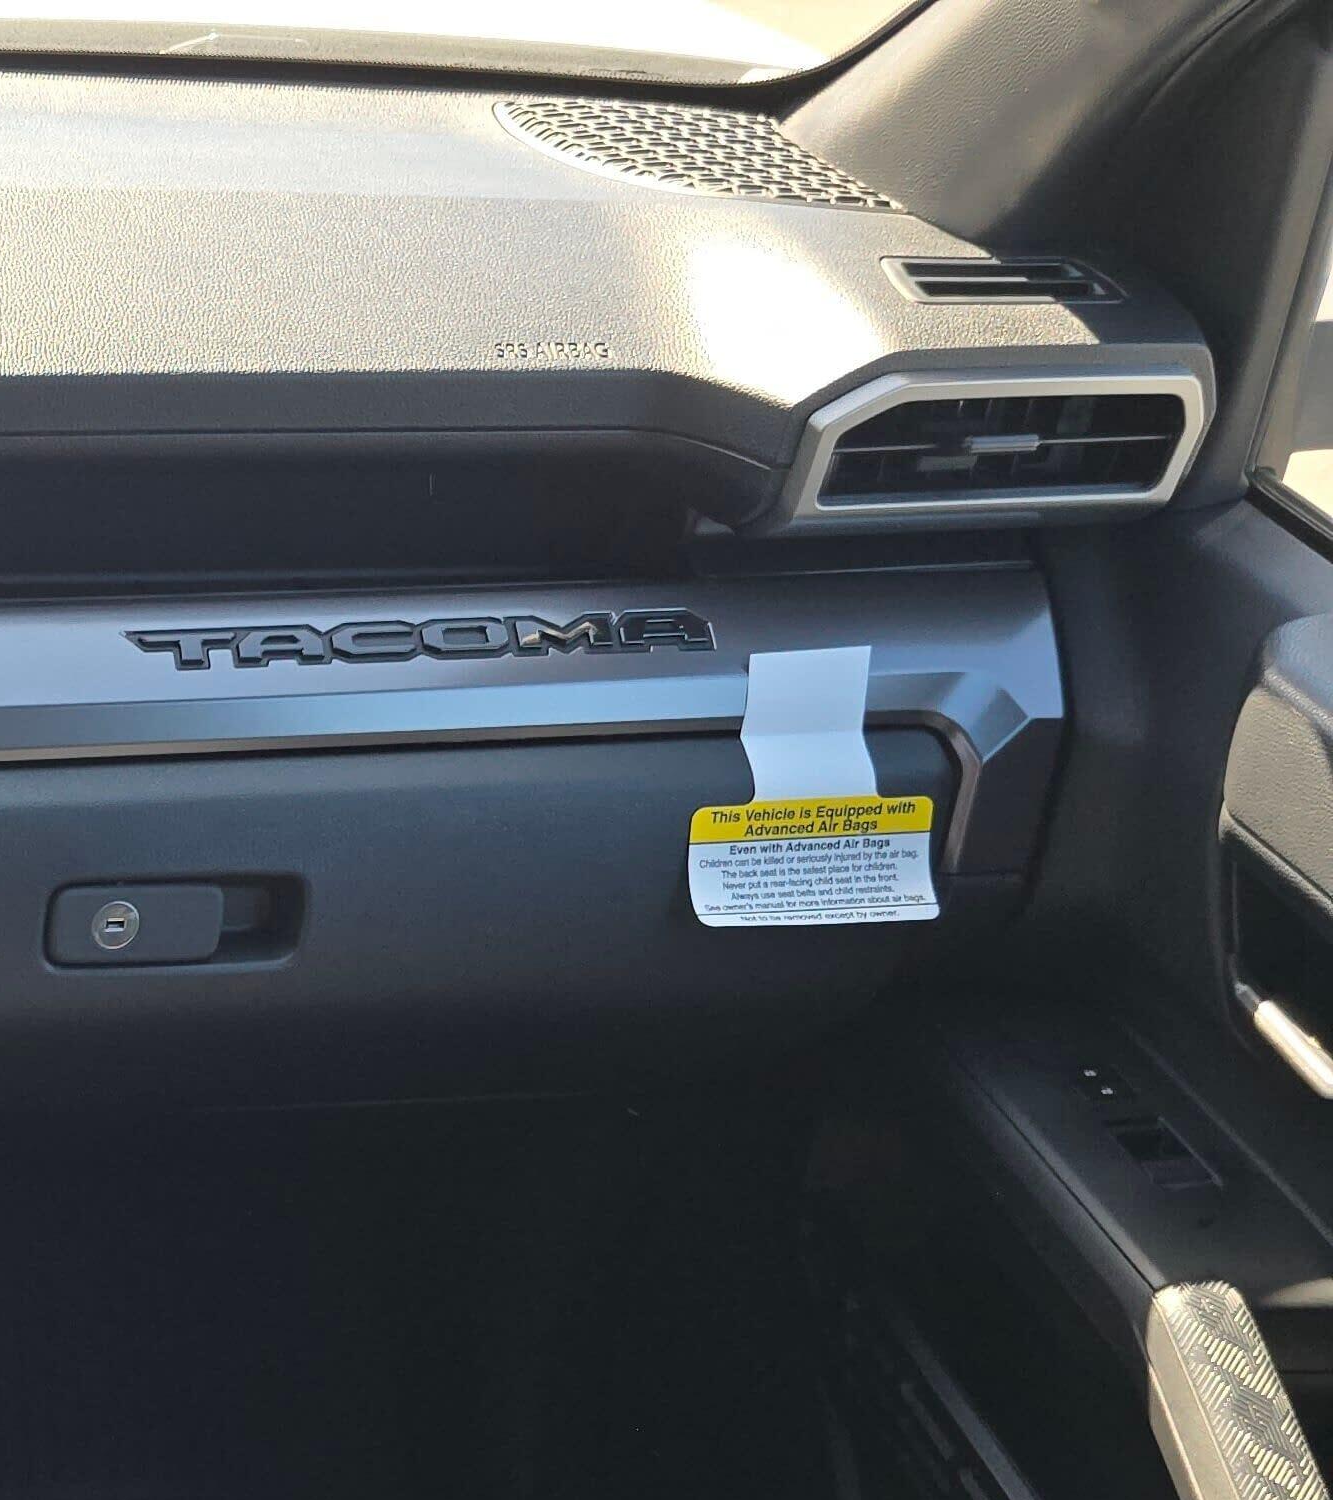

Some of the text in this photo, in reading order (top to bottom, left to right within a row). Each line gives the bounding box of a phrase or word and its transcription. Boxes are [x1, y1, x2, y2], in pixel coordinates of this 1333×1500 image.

[494, 342, 610, 358] SRS AIRBAG
[121, 607, 717, 670] TACOMA
[711, 801, 916, 824] This Vehicle is Equipped with
[744, 820, 877, 837] Advanced Air Bags
[729, 838, 890, 855] Even with Advanced Air Bags
[699, 859, 733, 869] Children
[751, 858, 761, 866] be
[764, 856, 784, 865] killed
[797, 853, 832, 865] seriously
[834, 852, 861, 862] injured
[863, 851, 873, 861] by
[874, 851, 888, 859] the
[889, 850, 900, 858] air
[722, 870, 737, 878] The
[739, 869, 758, 877] back
[759, 868, 777, 876] seat
[779, 868, 785, 876] is
[787, 867, 800, 875] the
[803, 865, 827, 874] safest
[828, 865, 850, 874] place
[852, 863, 862, 872] for
[722, 882, 746, 890] Never
[748, 881, 761, 890] put
[814, 877, 833, 885] child
[835, 876, 851, 884] seat
[854, 875, 862, 883] in
[732, 893, 759, 901] Always
[818, 888, 833, 896] and
[835, 886, 853, 895] child
[821, 897, 865, 905] information
[857, 911, 867, 919] by
